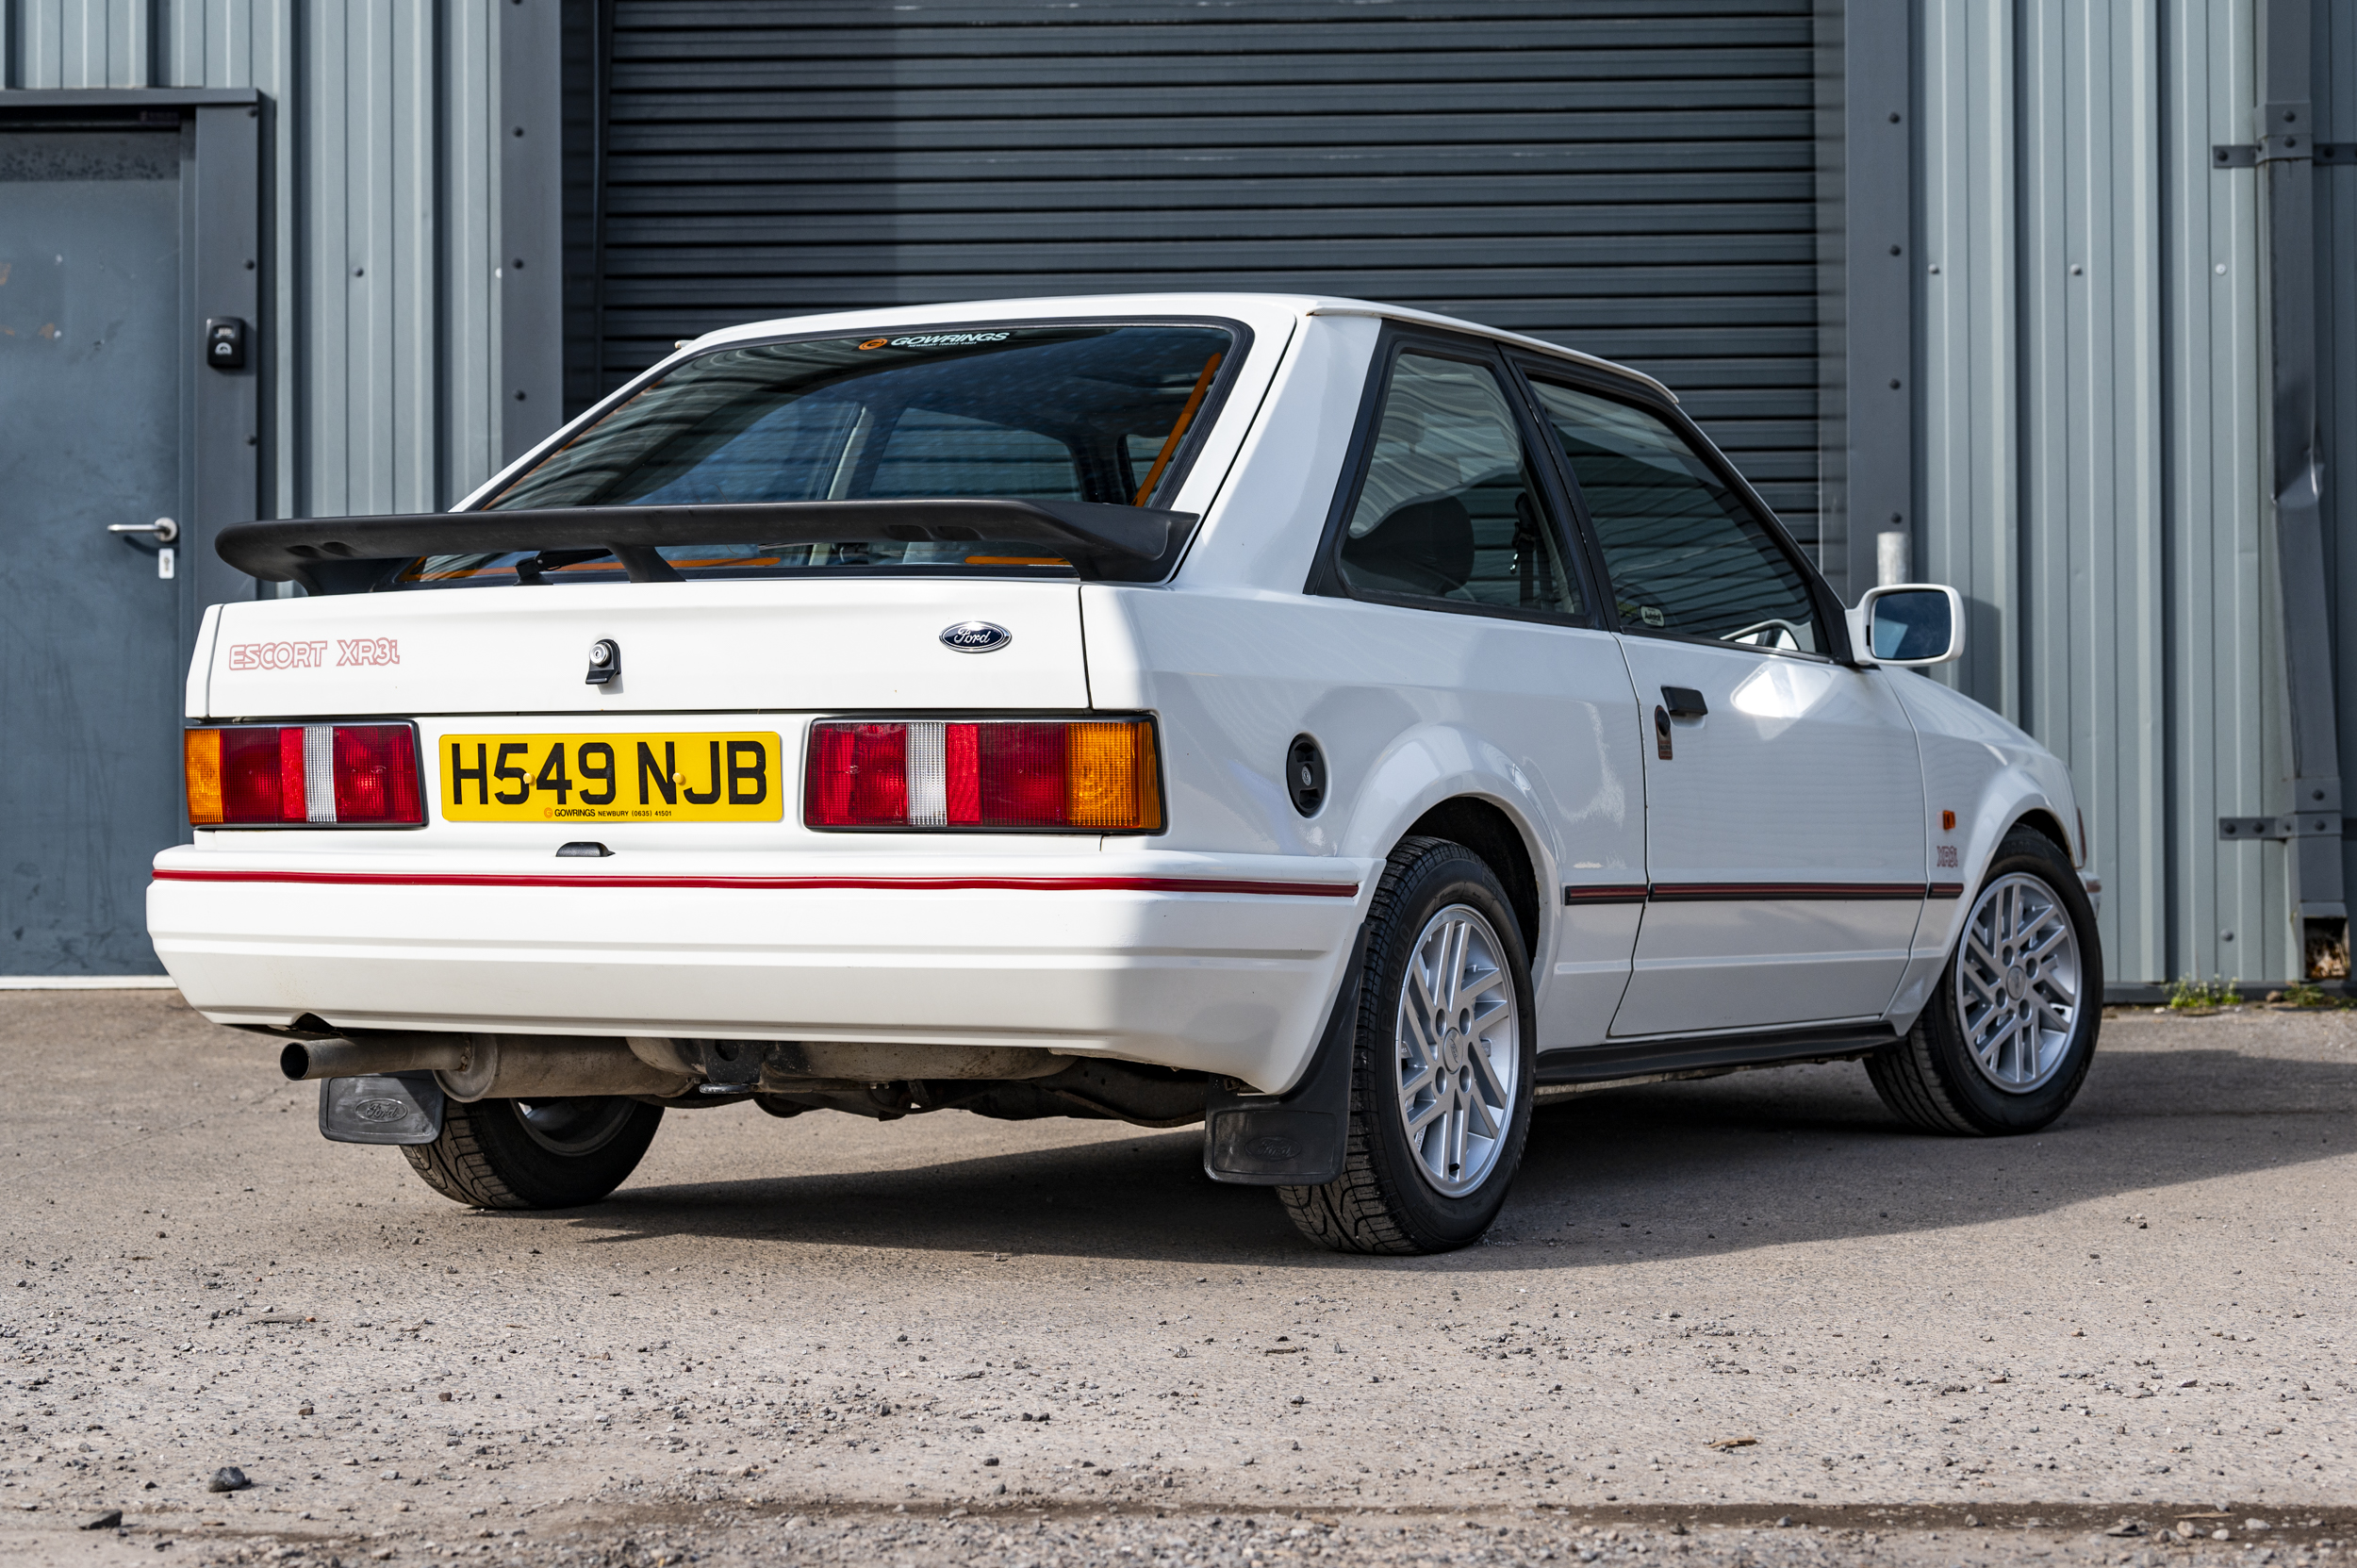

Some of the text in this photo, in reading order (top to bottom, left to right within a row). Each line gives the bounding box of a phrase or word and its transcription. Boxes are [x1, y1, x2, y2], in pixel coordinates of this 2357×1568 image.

[891, 332, 1010, 346] GOWRINGS
[954, 626, 991, 644] Ford
[228, 636, 401, 670] ESCORT XR3i
[451, 740, 766, 805] H549 NJB
[554, 808, 596, 817] GOWRINGS
